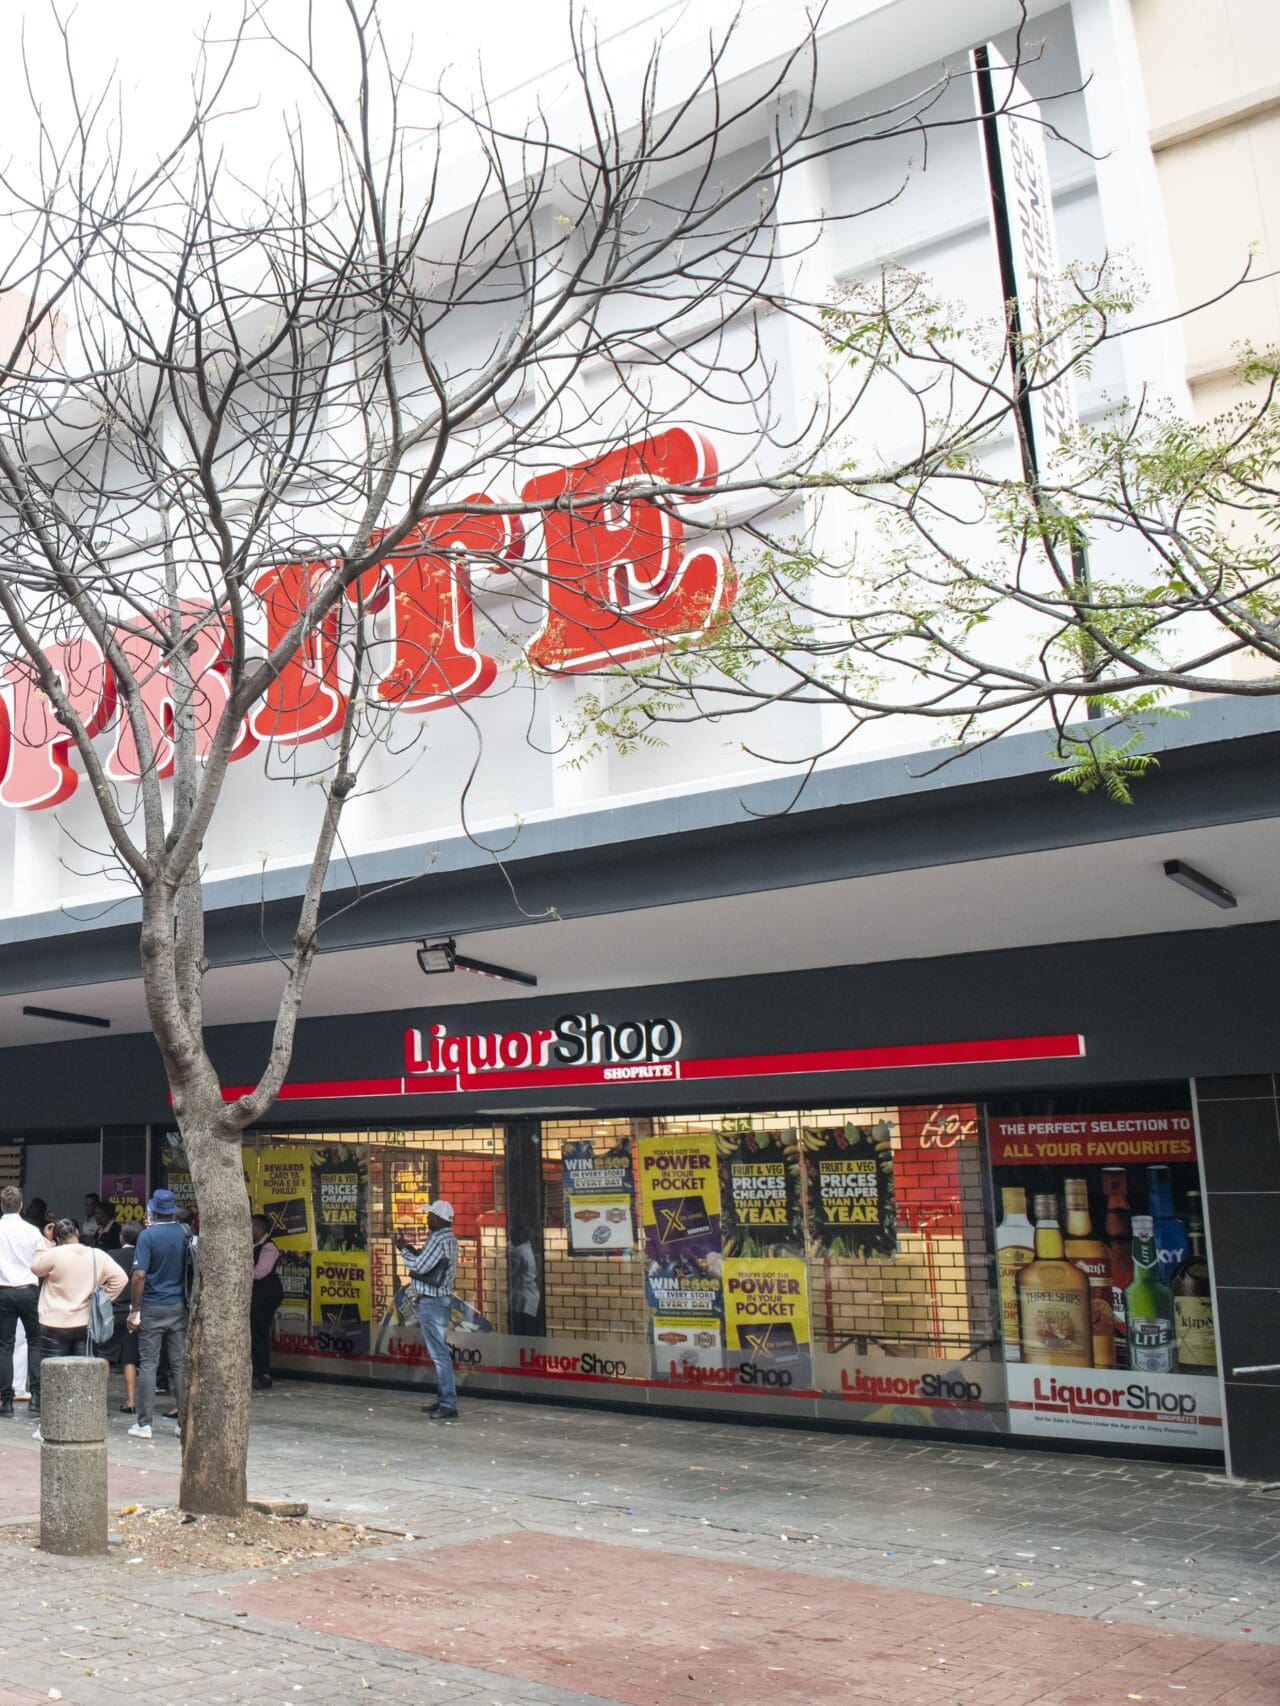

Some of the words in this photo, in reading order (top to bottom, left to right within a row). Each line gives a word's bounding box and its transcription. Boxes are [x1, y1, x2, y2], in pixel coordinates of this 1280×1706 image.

[404, 1013, 682, 1076] LiquorShop
[604, 1065, 672, 1080] SHOPRITE
[999, 1124, 1025, 1136] THE
[1028, 1122, 1087, 1134] PERFECT
[1091, 1119, 1168, 1133] SELECTION
[1172, 1118, 1190, 1131] TO
[1003, 1144, 1033, 1158] ALL
[1036, 1143, 1082, 1157] YOUR
[1087, 1140, 1191, 1156] FAVOURITES
[264, 1163, 304, 1172] REWARDS
[565, 1159, 593, 1170] WIN
[644, 1155, 712, 1171] POWER
[821, 1163, 842, 1173] FRUIT
[846, 1162, 853, 1172] &
[857, 1161, 874, 1172] VEG
[269, 1171, 288, 1179] CARD
[581, 1170, 601, 1178] EVERY
[733, 1165, 753, 1175] FRUIT
[756, 1165, 763, 1174] &
[766, 1164, 782, 1174] VEG
[575, 1179, 602, 1187] EVERY
[604, 1178, 621, 1186] DAY
[652, 1178, 706, 1190] POCKET
[732, 1176, 786, 1189] PRICES
[820, 1174, 877, 1187] PRICES
[321, 1185, 358, 1195] PRICES
[733, 1189, 786, 1199] CHEAPER
[821, 1187, 878, 1197] CHEAPER
[321, 1195, 357, 1203] CHEAPER
[734, 1200, 762, 1208] THAN
[822, 1198, 849, 1206] THAN
[853, 1198, 877, 1206] LAST
[114, 1204, 144, 1223] 299
[322, 1210, 357, 1222] YEAR
[735, 1208, 787, 1223] YEAR
[824, 1207, 879, 1222] YEAR
[316, 1266, 365, 1281] POWER
[649, 1278, 678, 1290] WIN
[728, 1278, 800, 1295] POWER
[320, 1287, 360, 1298] POCKET
[691, 1291, 714, 1299] STORE
[1025, 1291, 1055, 1304] THREE
[1055, 1291, 1081, 1305] SHIPS
[660, 1300, 689, 1308] EVERY
[691, 1300, 712, 1308] DAY
[736, 1302, 795, 1316] POCKET
[1135, 1332, 1167, 1345] LITE
[519, 1348, 626, 1377] LiquorShop
[670, 1359, 792, 1386] LiquorShop
[841, 1368, 981, 1401] LiquorShop
[1034, 1377, 1197, 1414] LiquorShop
[1157, 1414, 1195, 1424] SHOPRITE
[1120, 1422, 1130, 1430] Age
